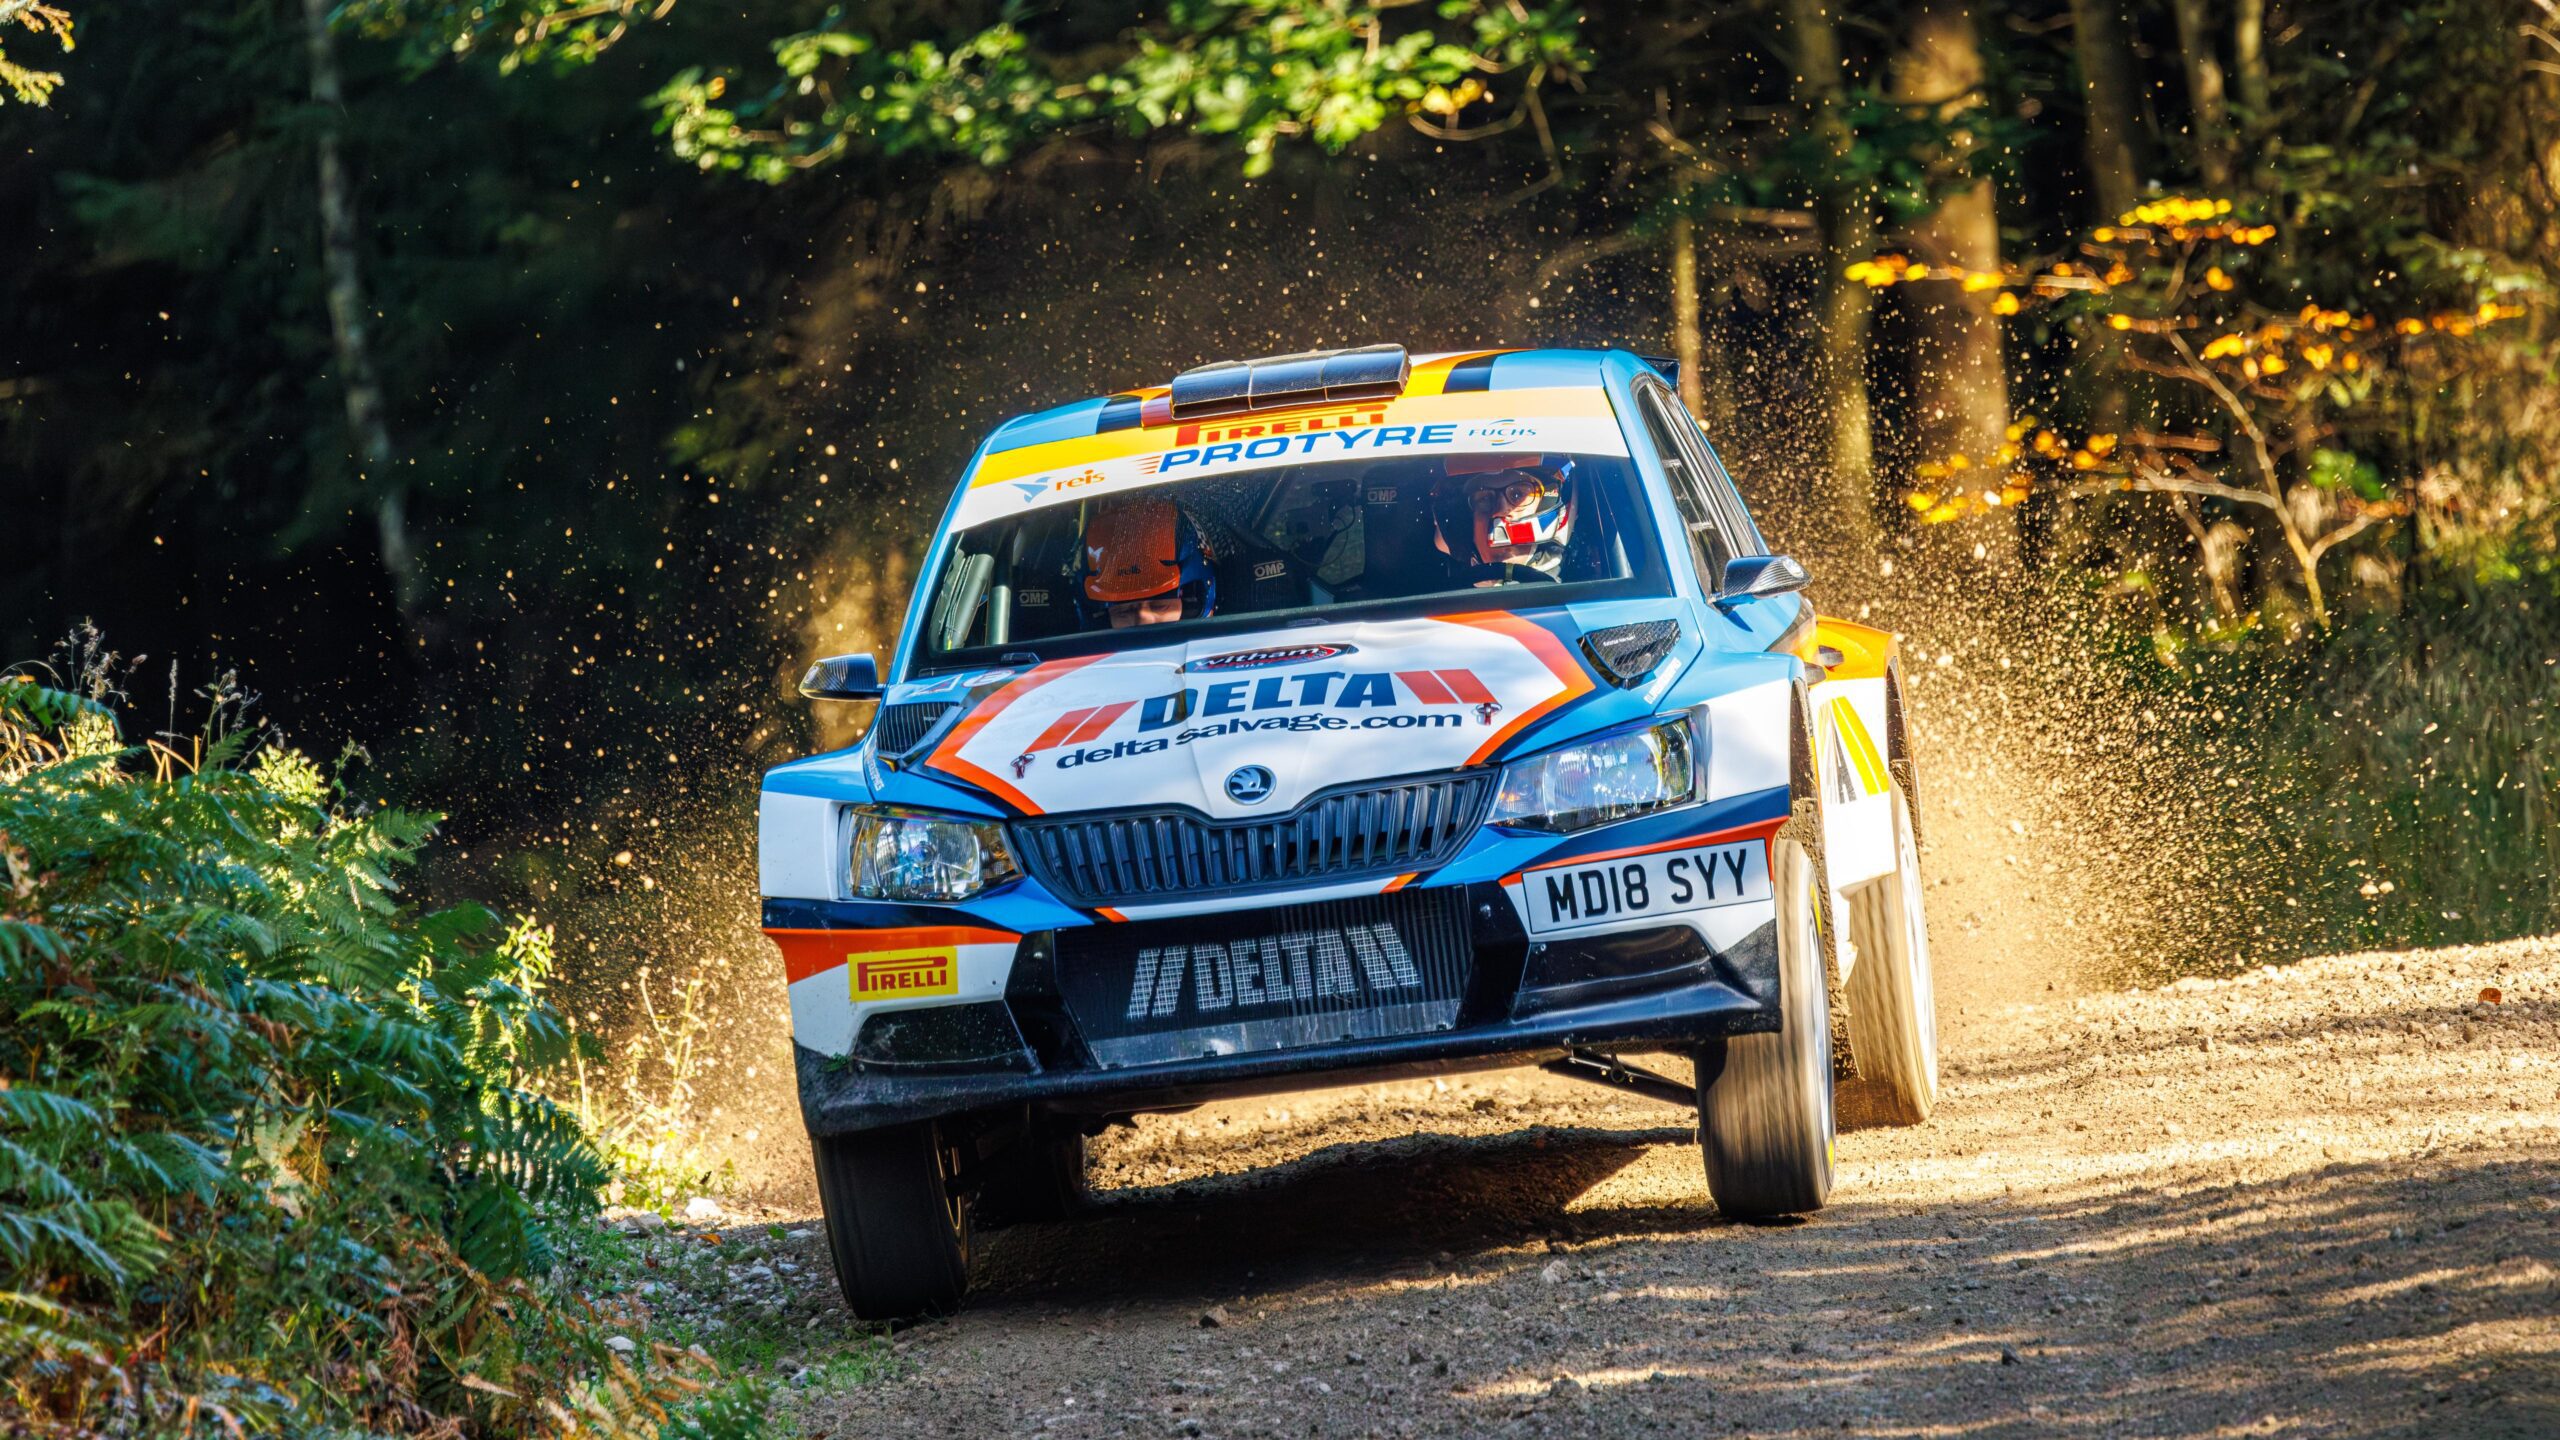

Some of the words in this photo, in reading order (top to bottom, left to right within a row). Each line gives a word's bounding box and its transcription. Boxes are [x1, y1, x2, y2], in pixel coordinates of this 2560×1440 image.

[1175, 403, 1387, 447] PIRELLI
[1468, 428, 1537, 438] FUCHS
[1158, 423, 1458, 473] PROTYRE
[1055, 469, 1105, 491] reis
[1254, 564, 1285, 578] OMP
[1019, 592, 1049, 605] OMP
[1138, 672, 1397, 733] DELTA
[1056, 739, 1168, 769] delta
[1175, 711, 1462, 746] salvage.com
[1545, 863, 1650, 923] MD18
[1666, 849, 1747, 905] SYY
[857, 956, 948, 992] PIRELLI
[1193, 929, 1357, 1010] DELTA
